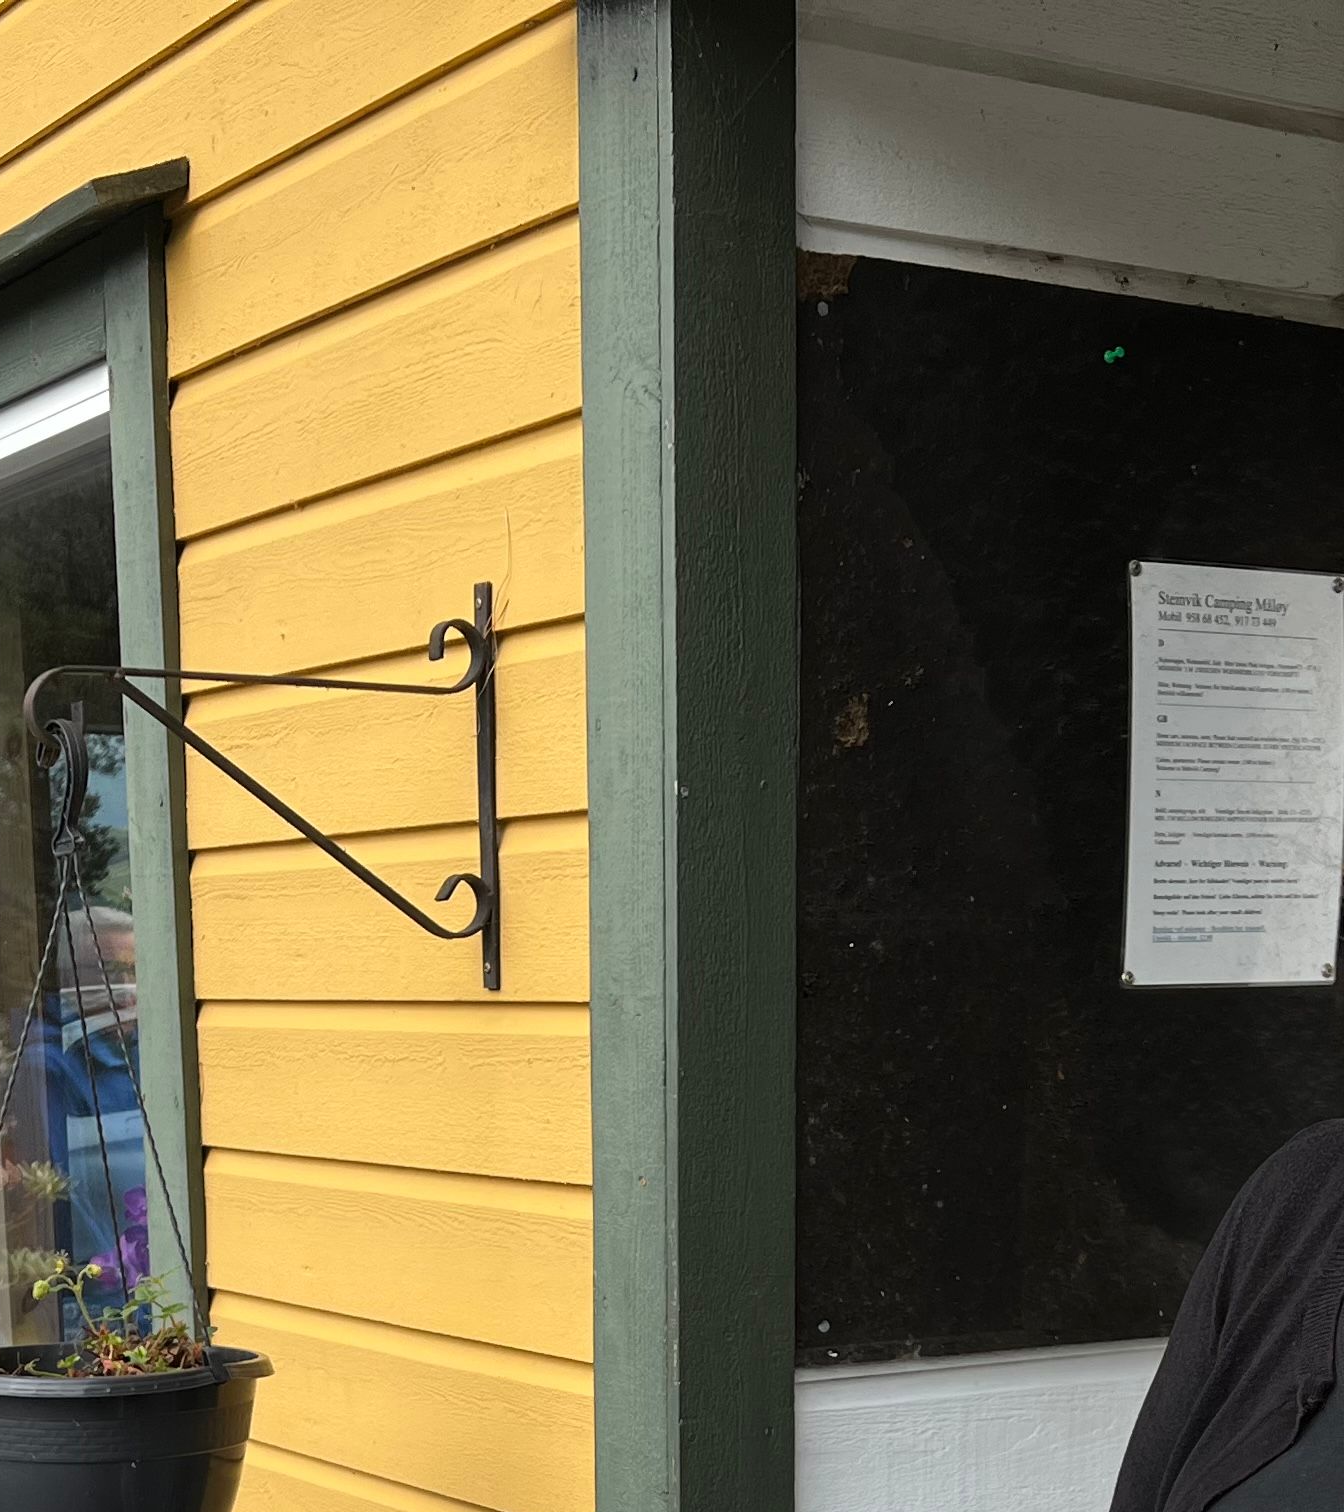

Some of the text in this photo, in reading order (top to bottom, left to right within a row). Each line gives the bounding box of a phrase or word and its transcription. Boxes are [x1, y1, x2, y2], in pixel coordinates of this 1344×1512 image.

[1158, 590, 1202, 607] Steinvik
[1205, 594, 1253, 614] Camping
[1158, 610, 1182, 622] Mobil
